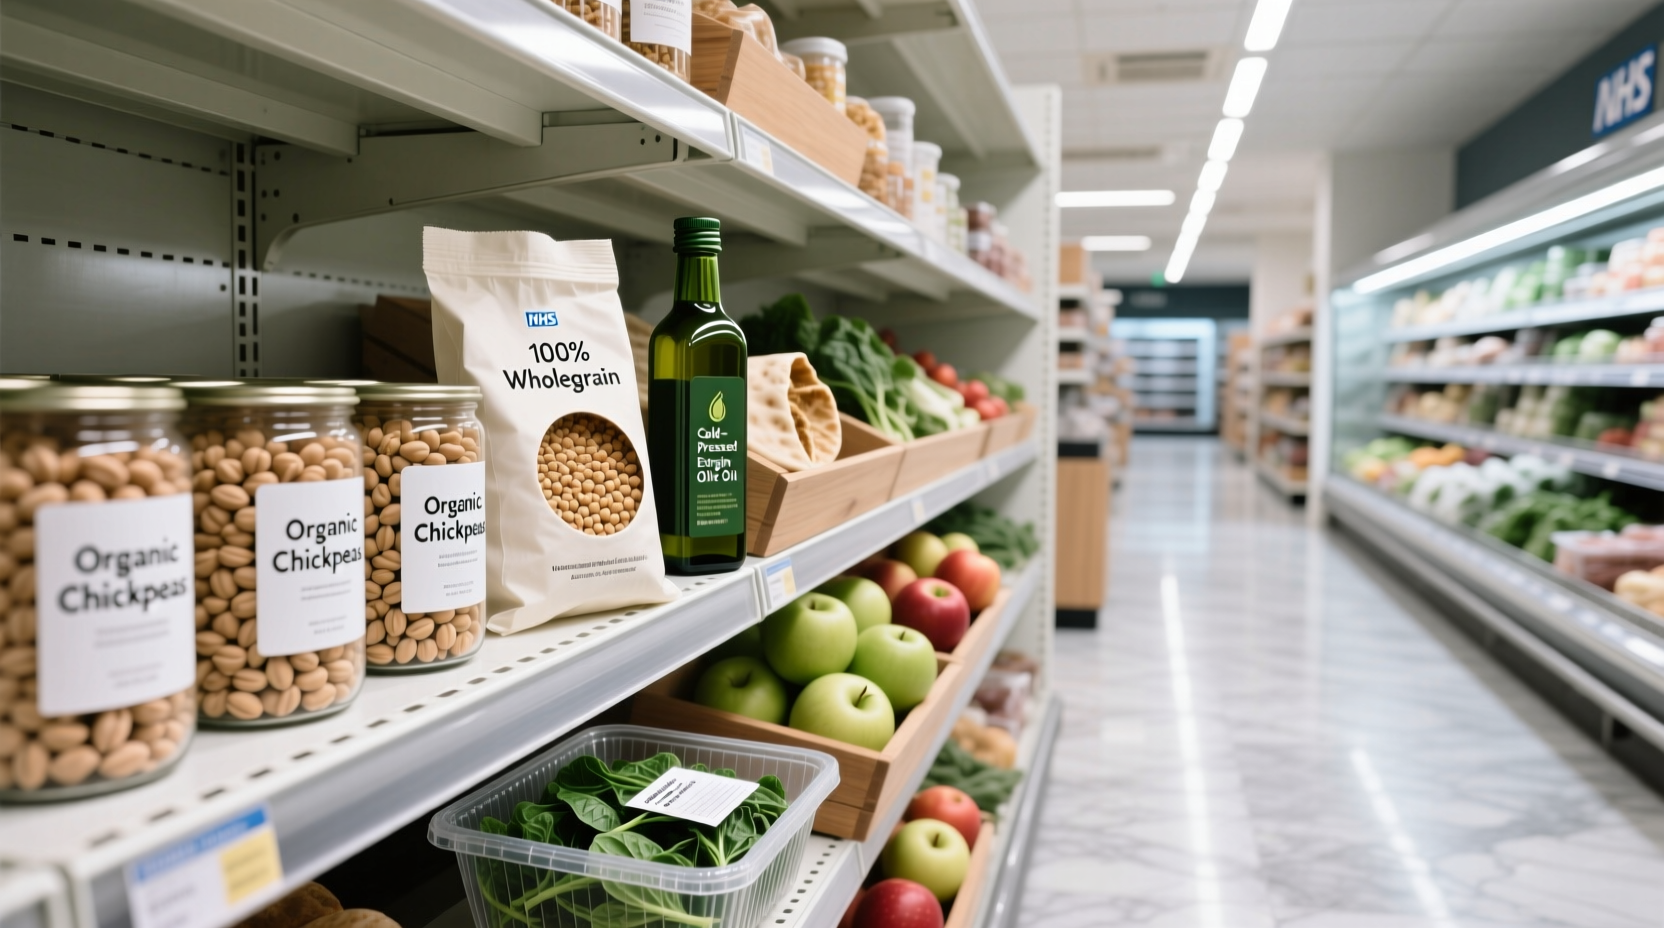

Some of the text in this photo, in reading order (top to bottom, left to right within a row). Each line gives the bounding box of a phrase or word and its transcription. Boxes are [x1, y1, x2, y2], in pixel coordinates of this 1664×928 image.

[1593, 49, 1655, 133] NHS
[528, 313, 558, 326] NHS
[528, 340, 590, 363] 100%
[503, 367, 621, 393] Wholegrain
[425, 491, 483, 518] Organic
[286, 512, 357, 544] Organic
[73, 537, 179, 577] Organic
[272, 546, 362, 574] Chickpeas
[57, 577, 187, 613] Chickpeas
